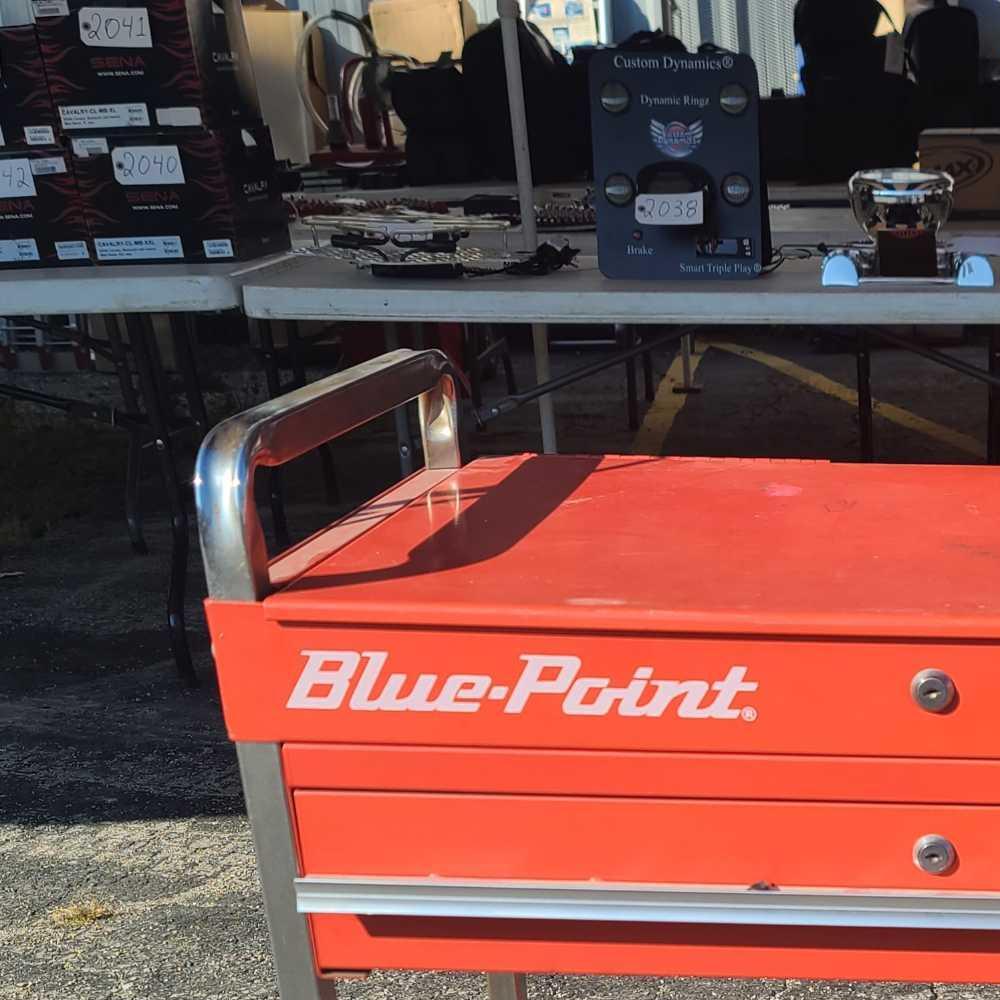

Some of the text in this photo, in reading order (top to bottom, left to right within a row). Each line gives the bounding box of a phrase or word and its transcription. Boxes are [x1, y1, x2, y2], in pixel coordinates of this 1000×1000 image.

[88, 12, 146, 41] 2041
[90, 55, 145, 69] SENA
[613, 56, 660, 70] Custom
[640, 94, 710, 107] Dynamic Ringz
[122, 151, 178, 178] 2040
[2, 166, 31, 189] 42
[643, 198, 698, 219] 2038
[627, 244, 655, 256] Brake
[680, 263, 707, 273] Smart
[708, 263, 732, 275] Triple
[734, 263, 752, 275] Play
